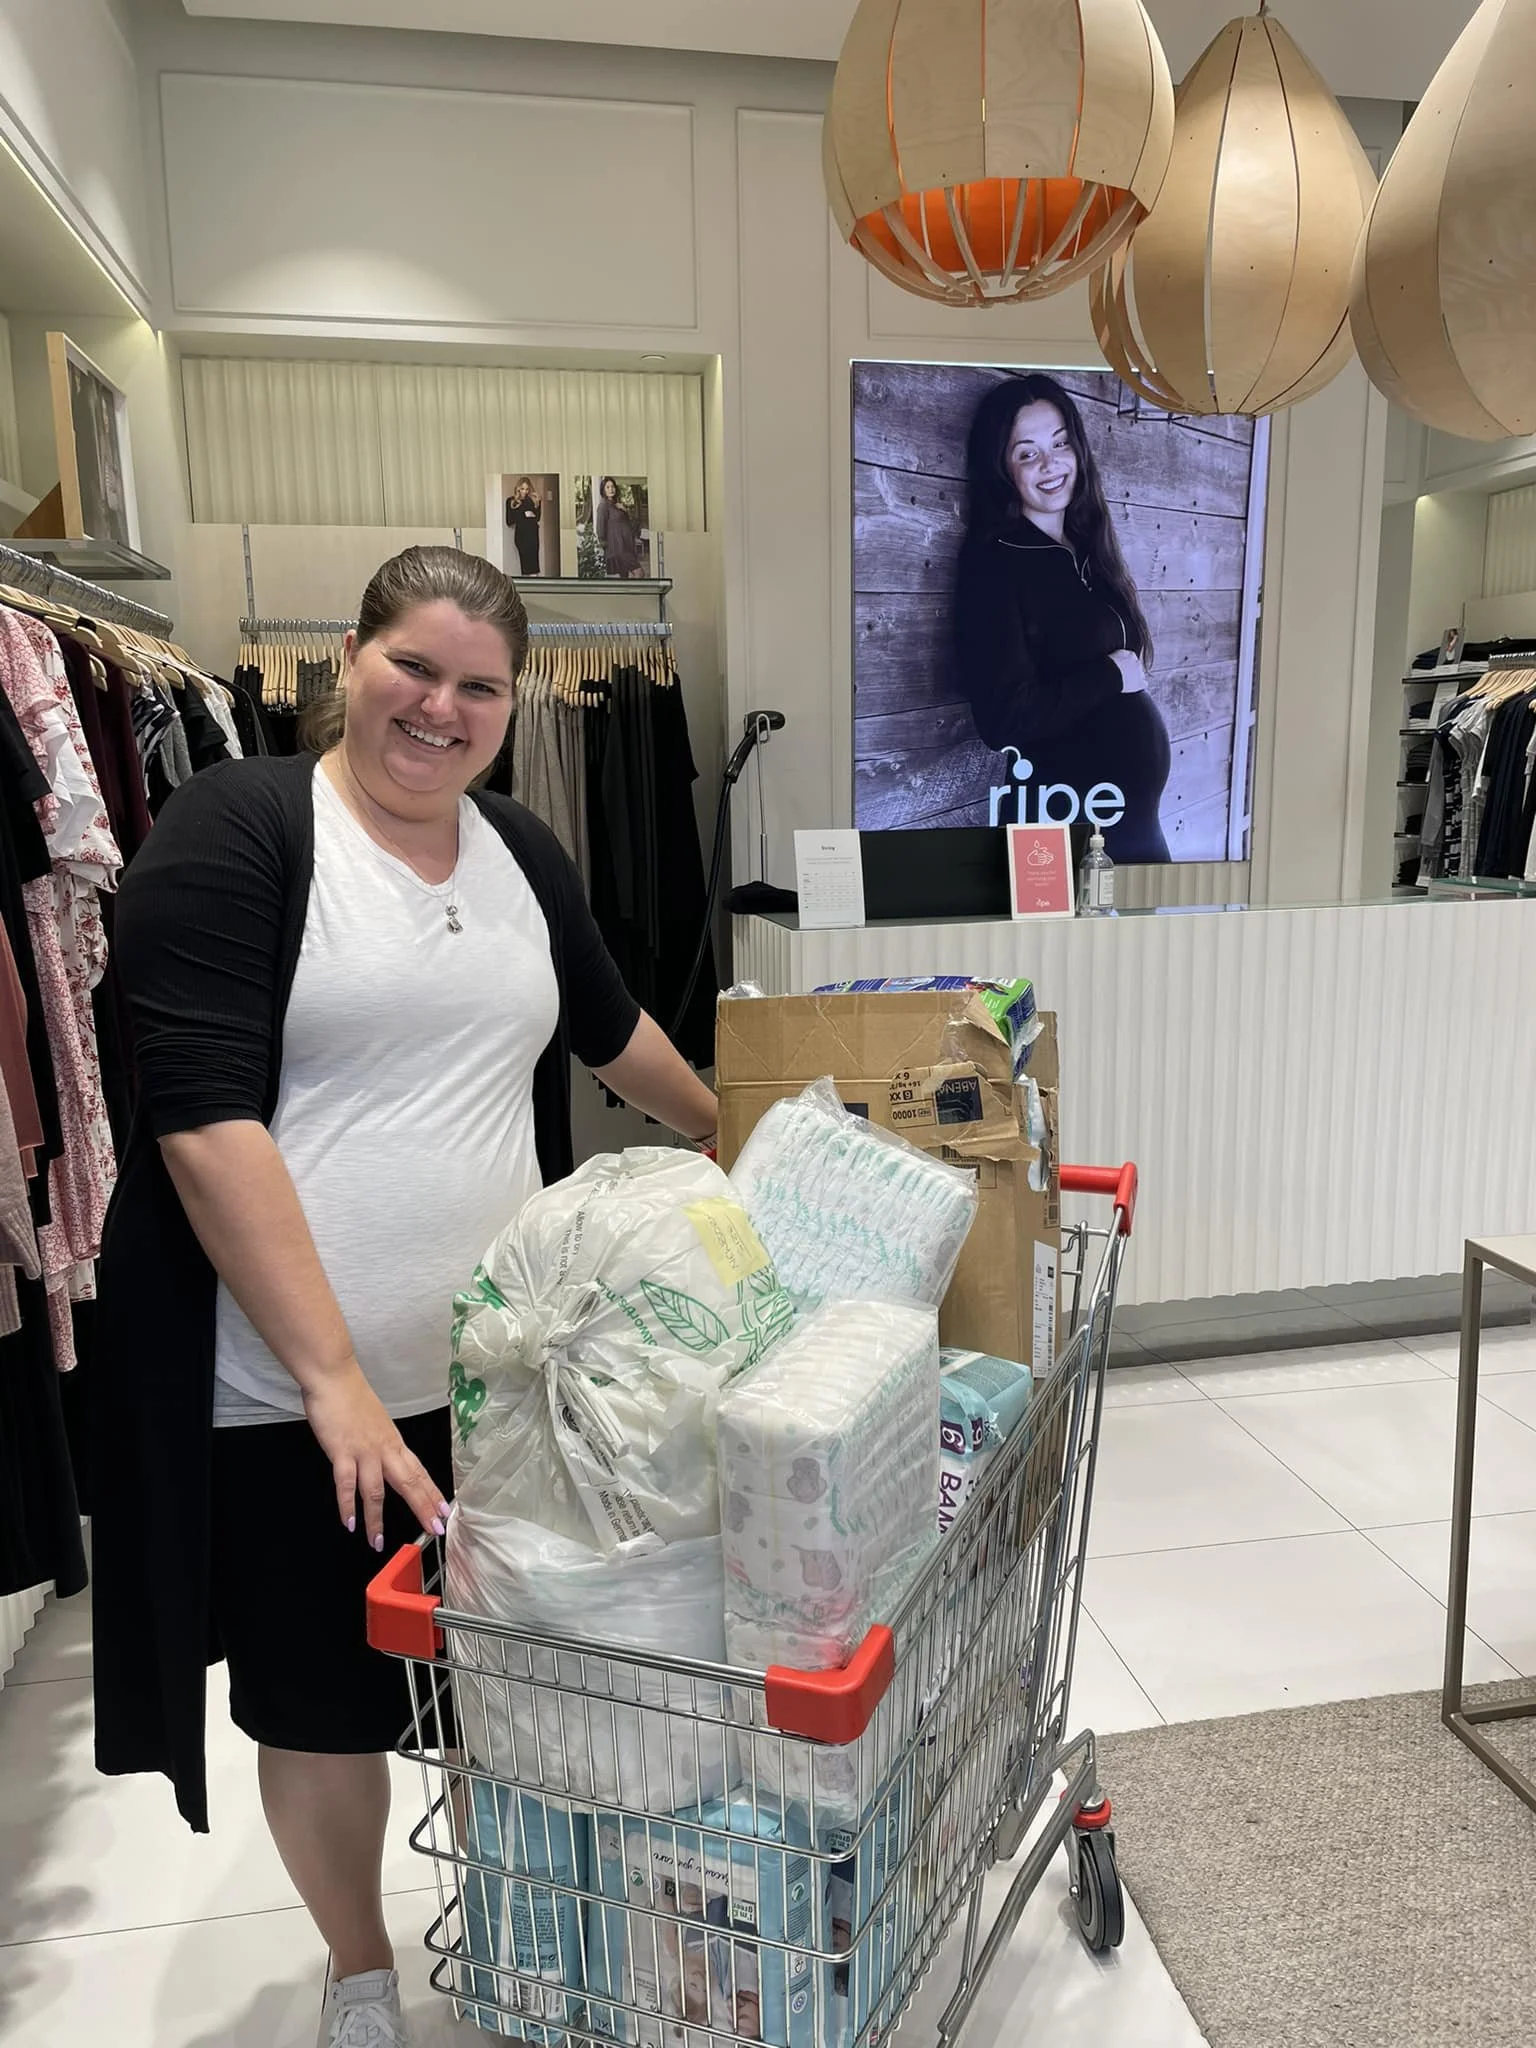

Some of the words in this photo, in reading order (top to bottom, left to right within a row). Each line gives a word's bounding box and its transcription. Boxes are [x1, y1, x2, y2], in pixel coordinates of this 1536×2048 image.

[989, 746, 1126, 828] ripe
[892, 1109, 917, 1120] 10000
[942, 1427, 964, 1447] 6
